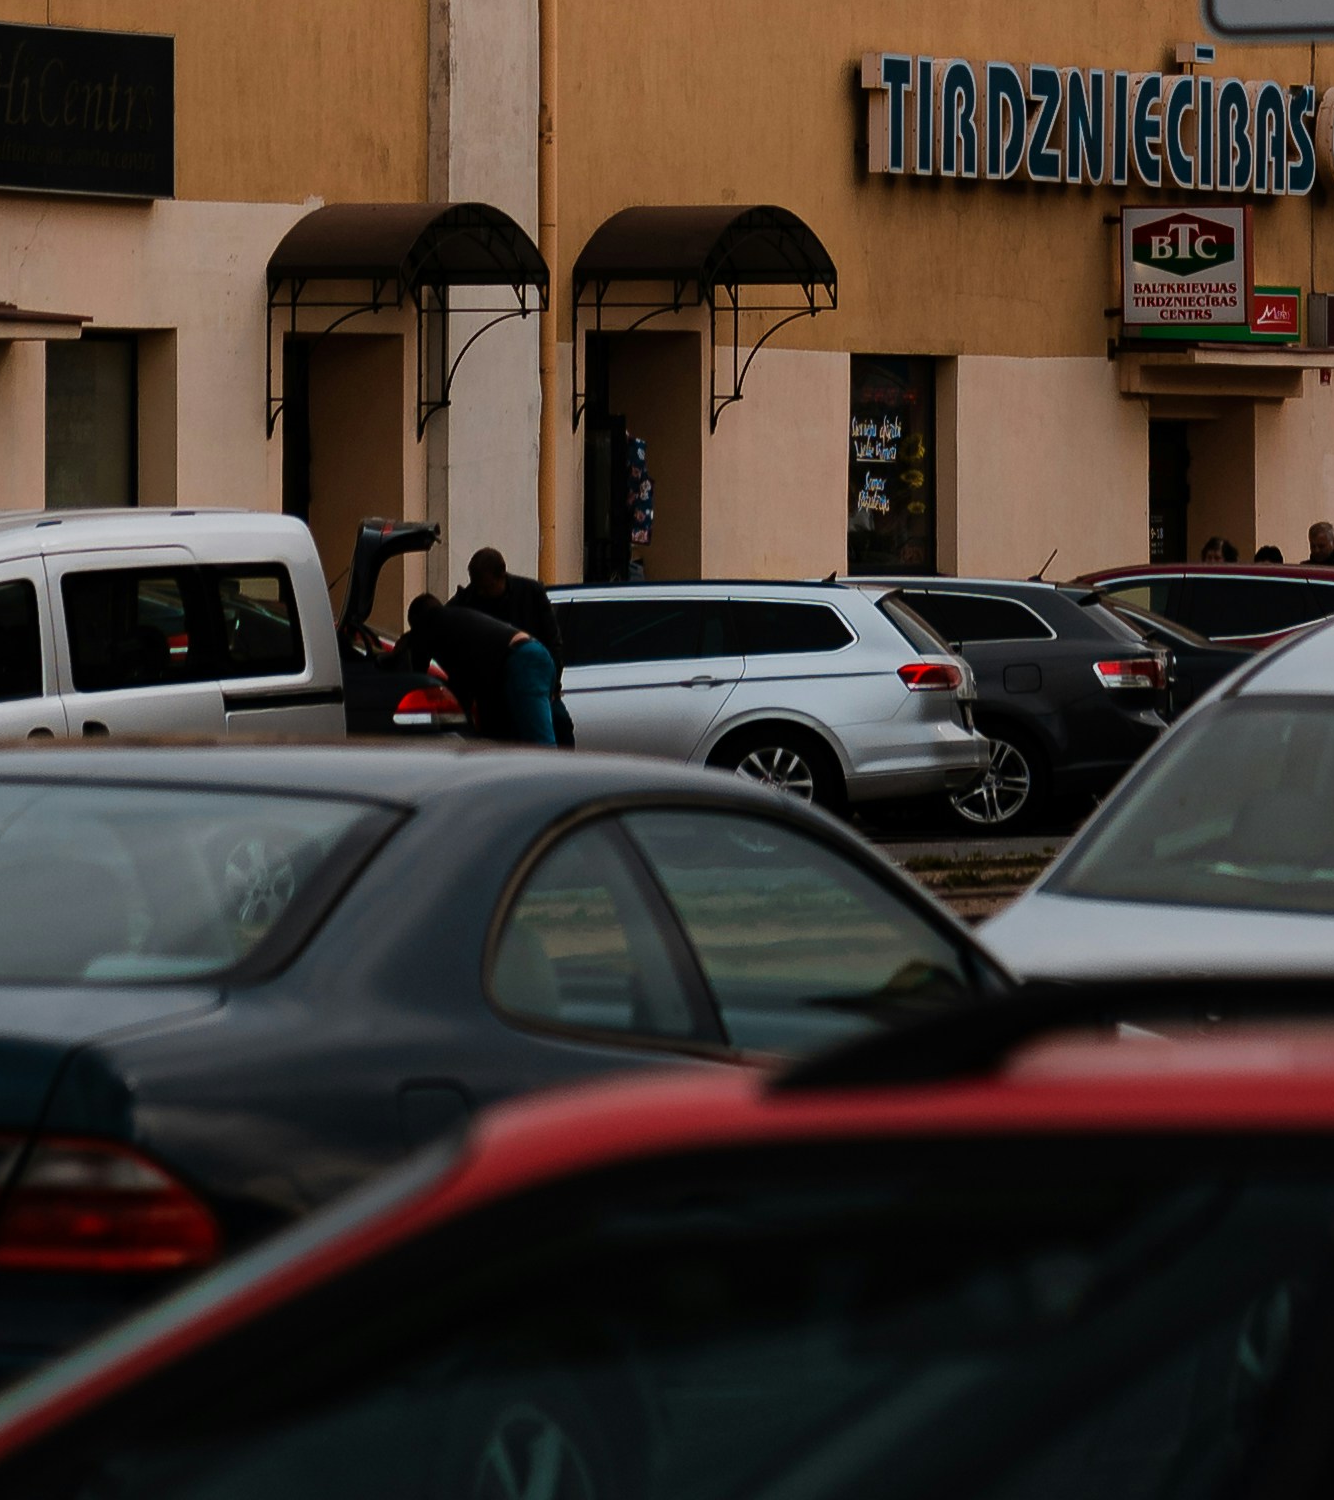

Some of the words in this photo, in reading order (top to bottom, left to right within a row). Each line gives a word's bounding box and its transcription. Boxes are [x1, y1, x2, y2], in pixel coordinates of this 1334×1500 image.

[881, 44, 1316, 196] TIRDZNIECĪBAS
[1151, 223, 1217, 260] BTC
[1133, 283, 1237, 295] BALTKRIEVIJAS
[1133, 295, 1237, 308] TIRDZNIECĪBAS
[1159, 309, 1212, 320] CENTRS
